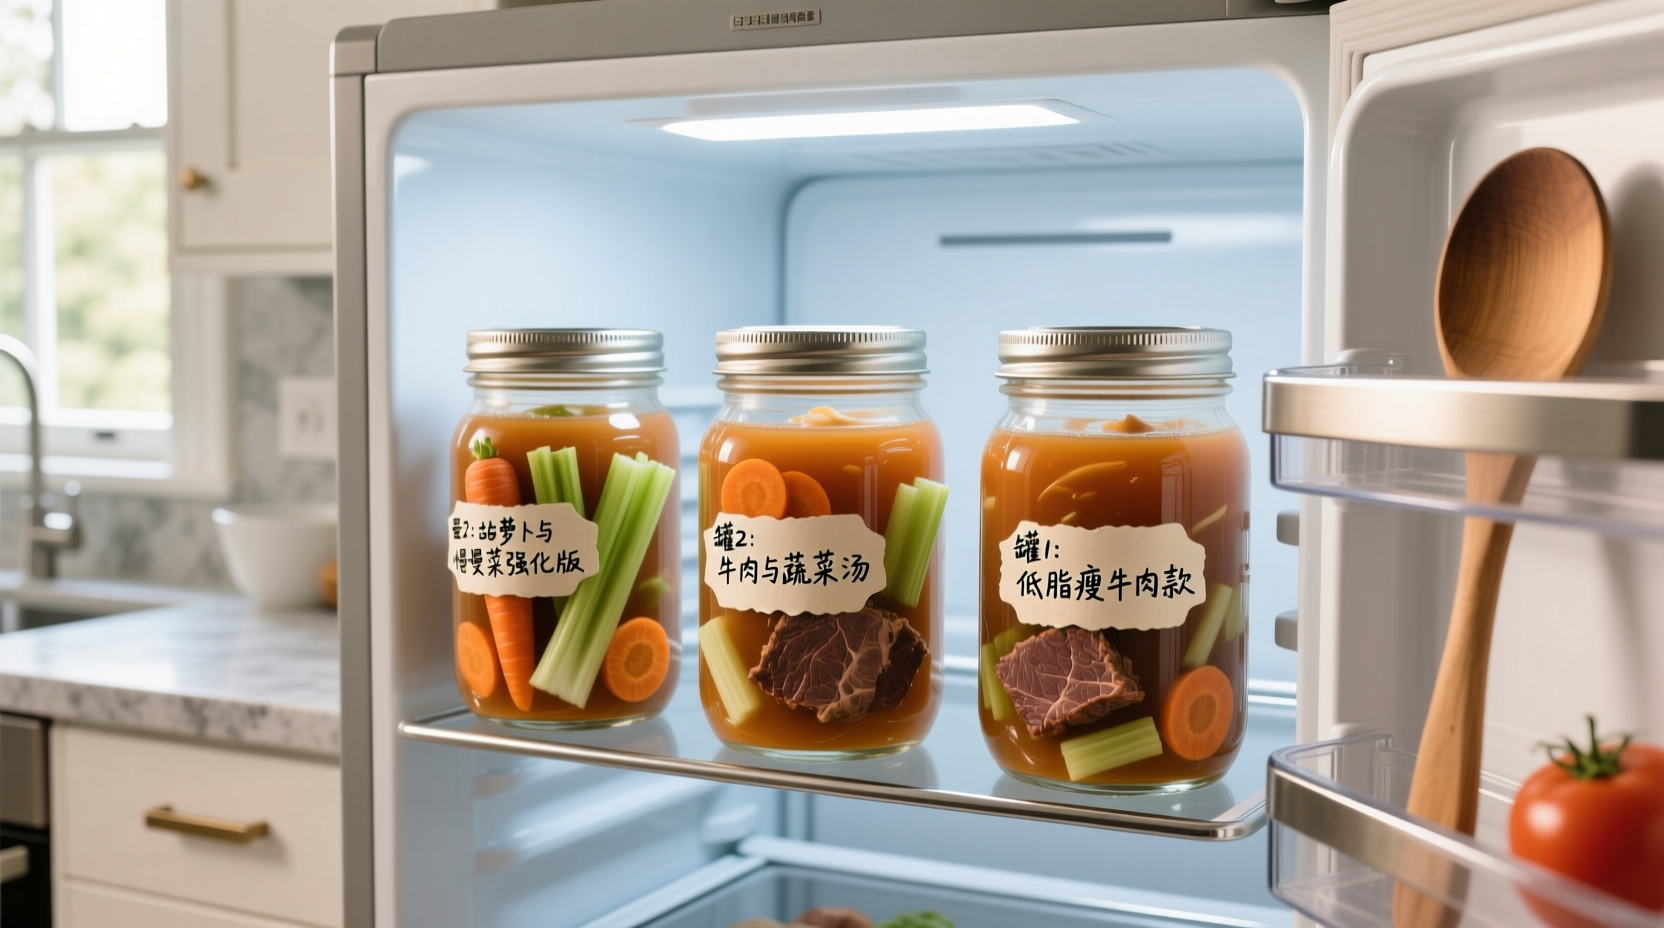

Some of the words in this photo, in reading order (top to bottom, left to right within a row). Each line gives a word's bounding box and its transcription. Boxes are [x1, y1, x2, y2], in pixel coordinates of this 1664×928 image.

[713, 521, 754, 551] 罐2:
[1013, 530, 1060, 563] 罐1:
[718, 549, 870, 586] 牛肉与蔬菜汤
[1016, 564, 1196, 602] 低脂瘦牛肉款
